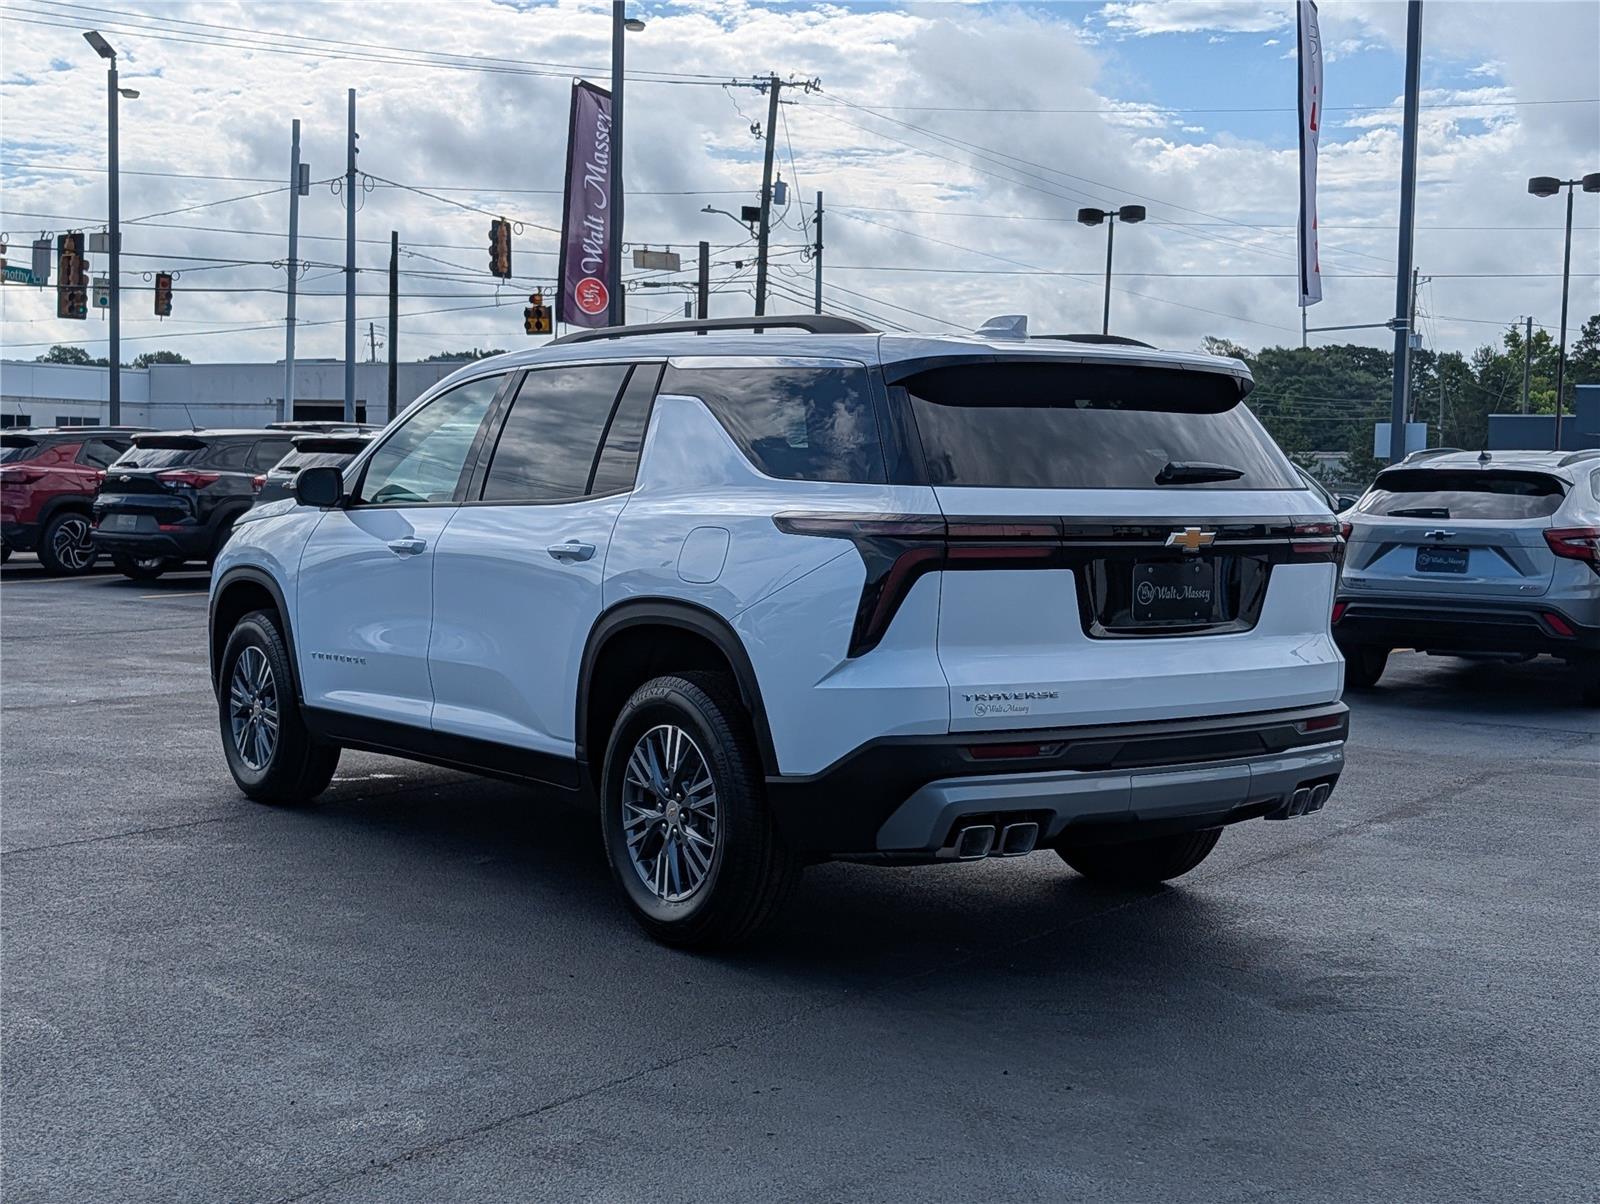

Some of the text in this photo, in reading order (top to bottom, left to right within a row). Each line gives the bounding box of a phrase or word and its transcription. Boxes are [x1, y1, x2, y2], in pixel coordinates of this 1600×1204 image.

[583, 107, 613, 210] Massey
[580, 214, 605, 275] Walt
[1154, 585, 1177, 600] Walt
[1177, 585, 1211, 603] Massey
[311, 652, 367, 665] TRAVERSE
[961, 690, 1060, 702] TRAVERSE
[986, 703, 1004, 714] Walt
[1004, 703, 1030, 714] Massey
